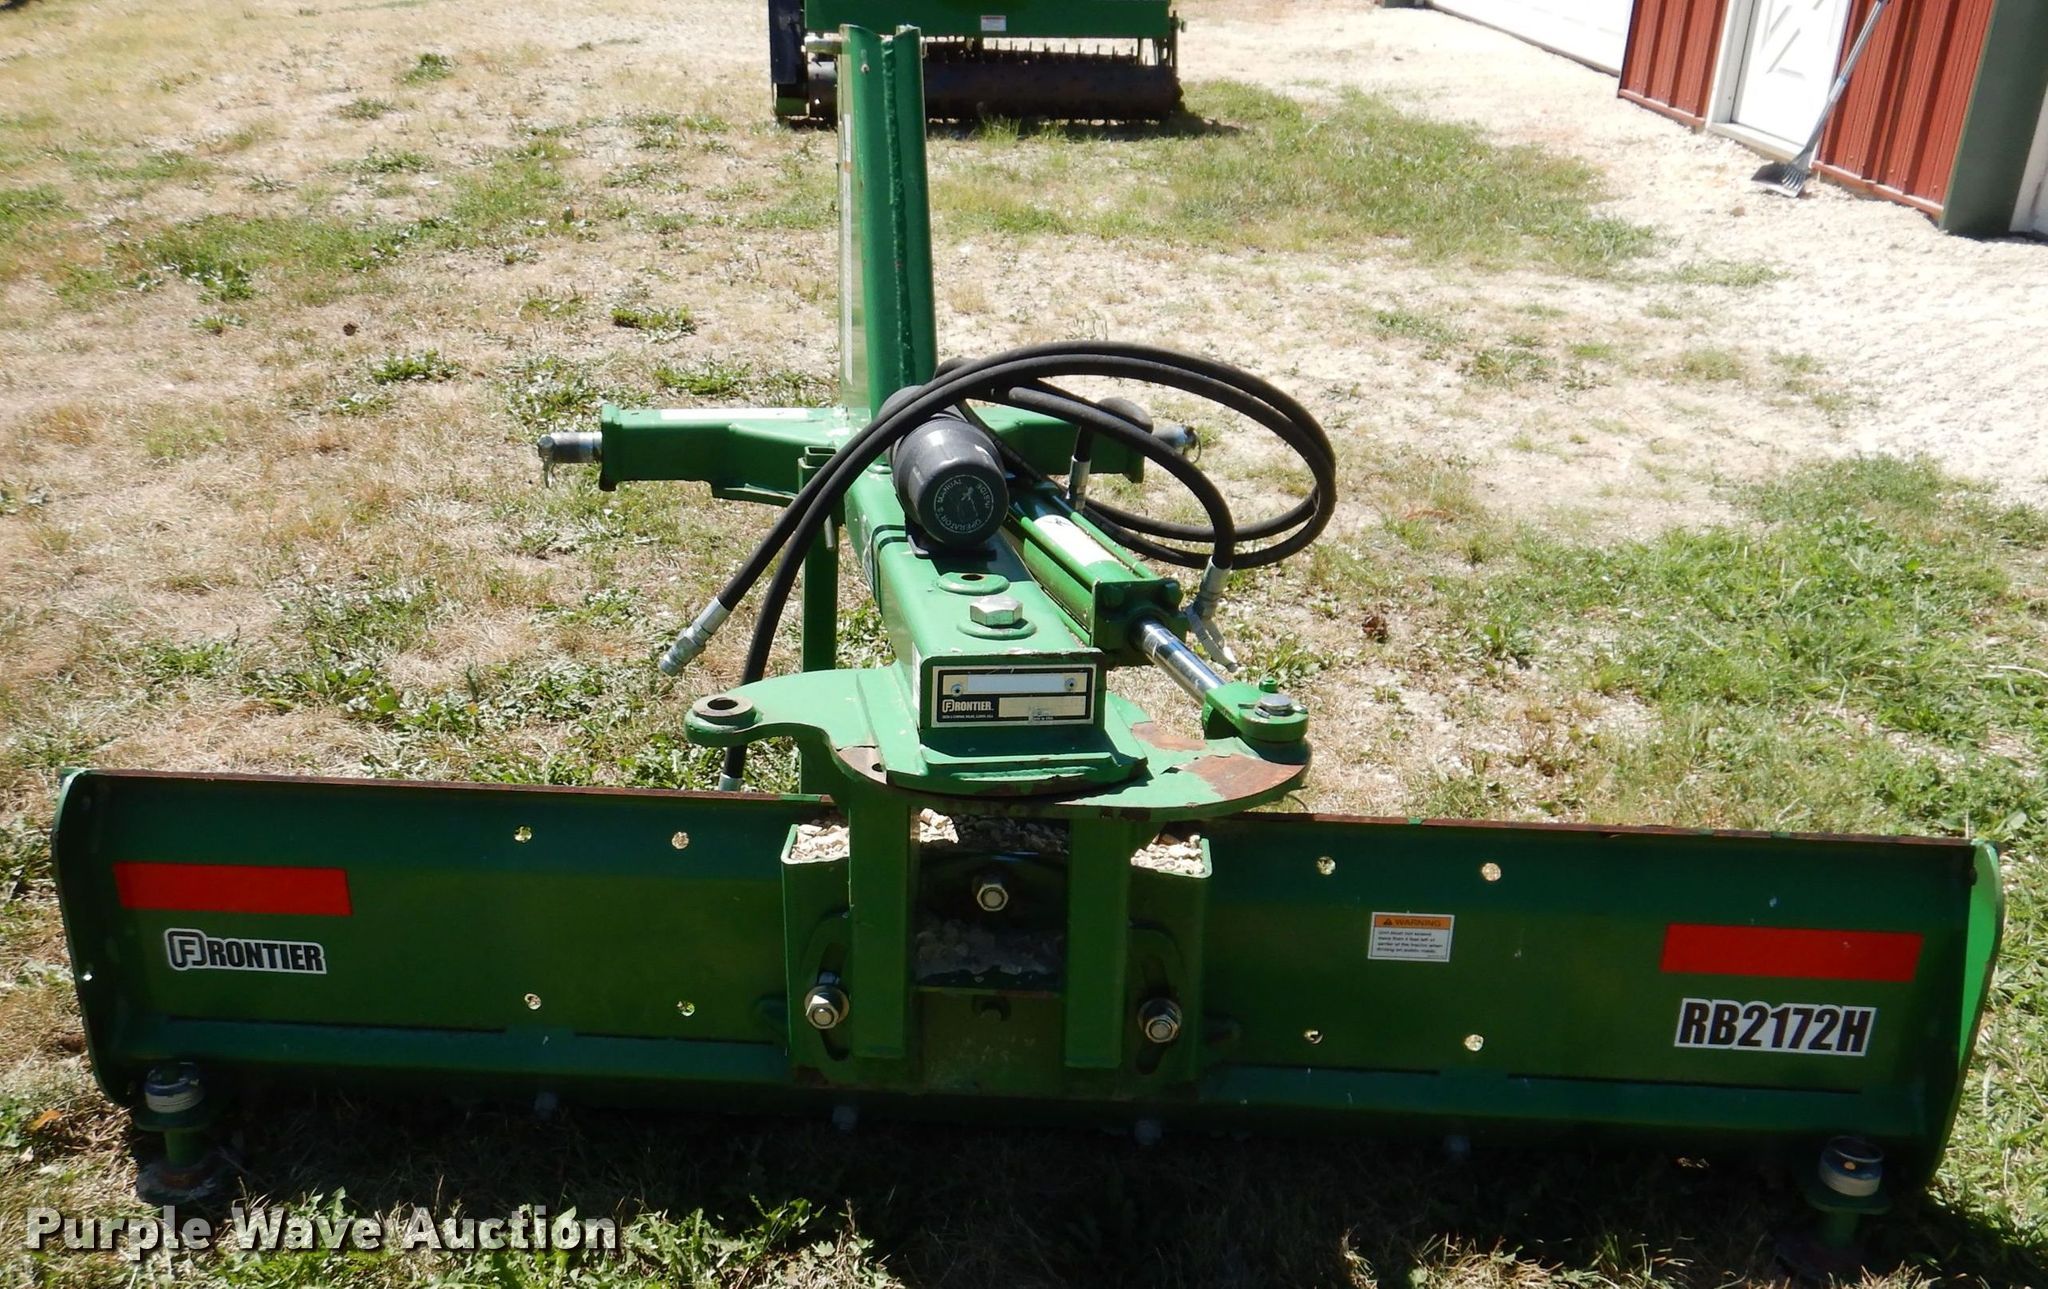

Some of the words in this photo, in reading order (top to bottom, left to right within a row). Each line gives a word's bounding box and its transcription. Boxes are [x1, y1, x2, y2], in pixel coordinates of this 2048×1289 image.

[942, 699, 992, 713] FRONTIER
[1395, 918, 1441, 927] WARNING
[167, 929, 325, 972] FRONTIER
[1677, 1001, 1872, 1053] RB2172H
